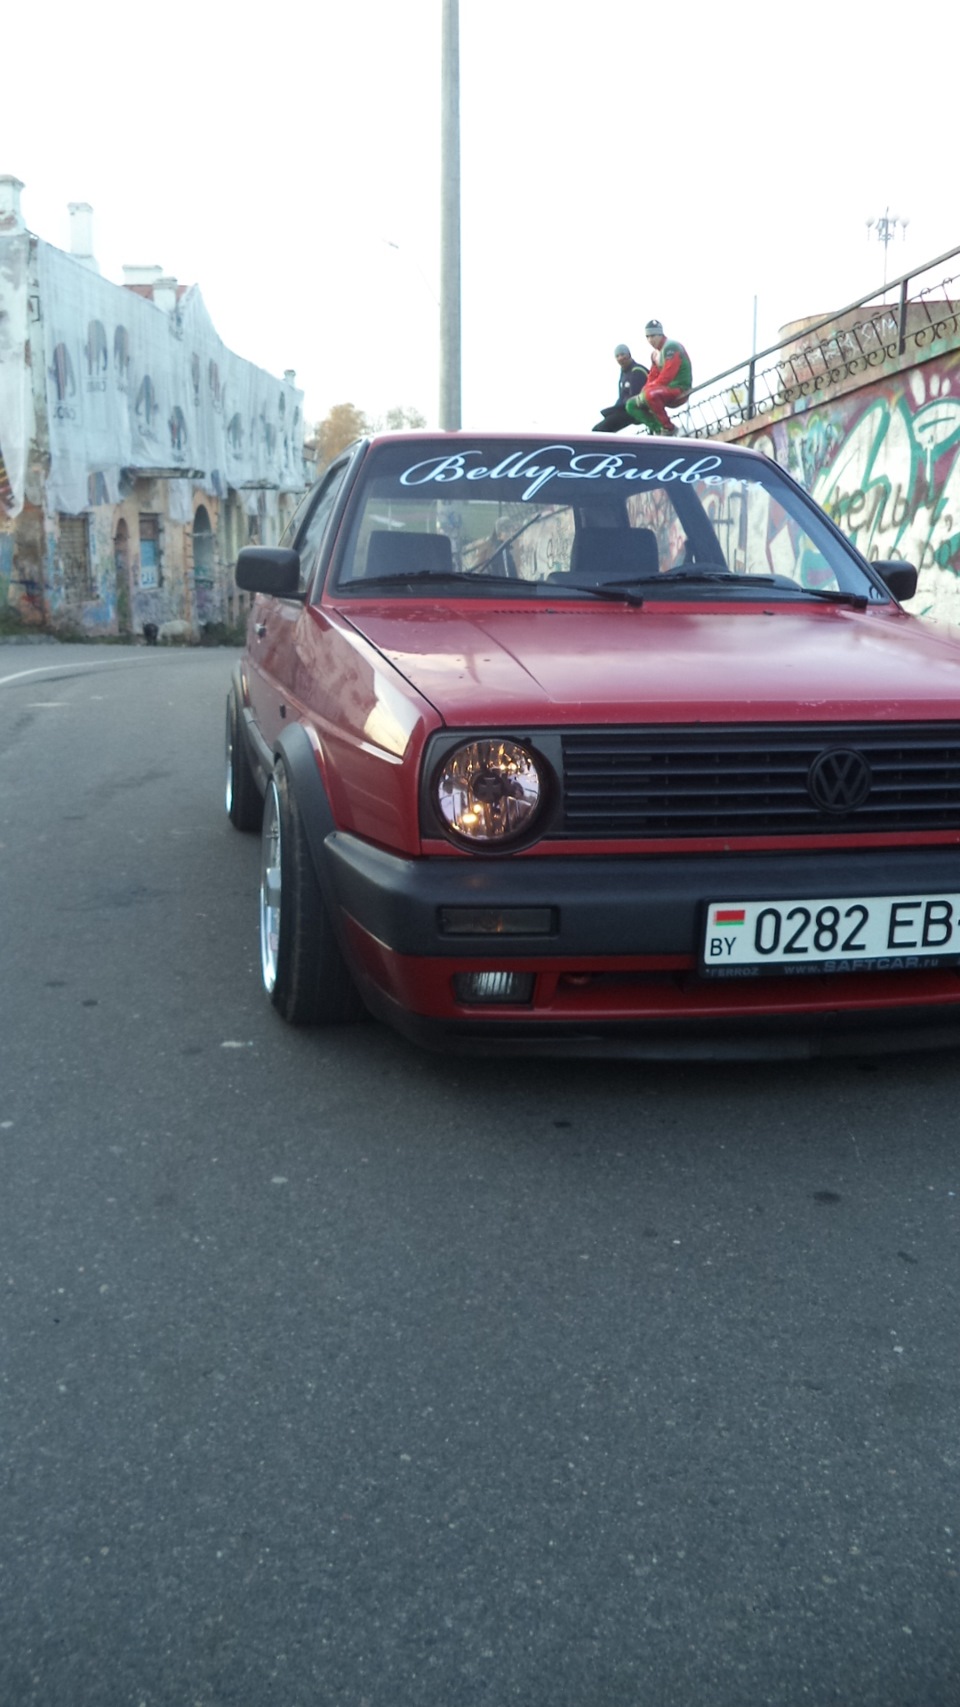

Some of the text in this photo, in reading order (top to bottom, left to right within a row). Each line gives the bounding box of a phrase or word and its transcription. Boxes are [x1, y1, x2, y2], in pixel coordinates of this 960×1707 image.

[400, 445, 575, 500] Belly
[710, 937, 737, 956] BY
[754, 904, 869, 955] 0282
